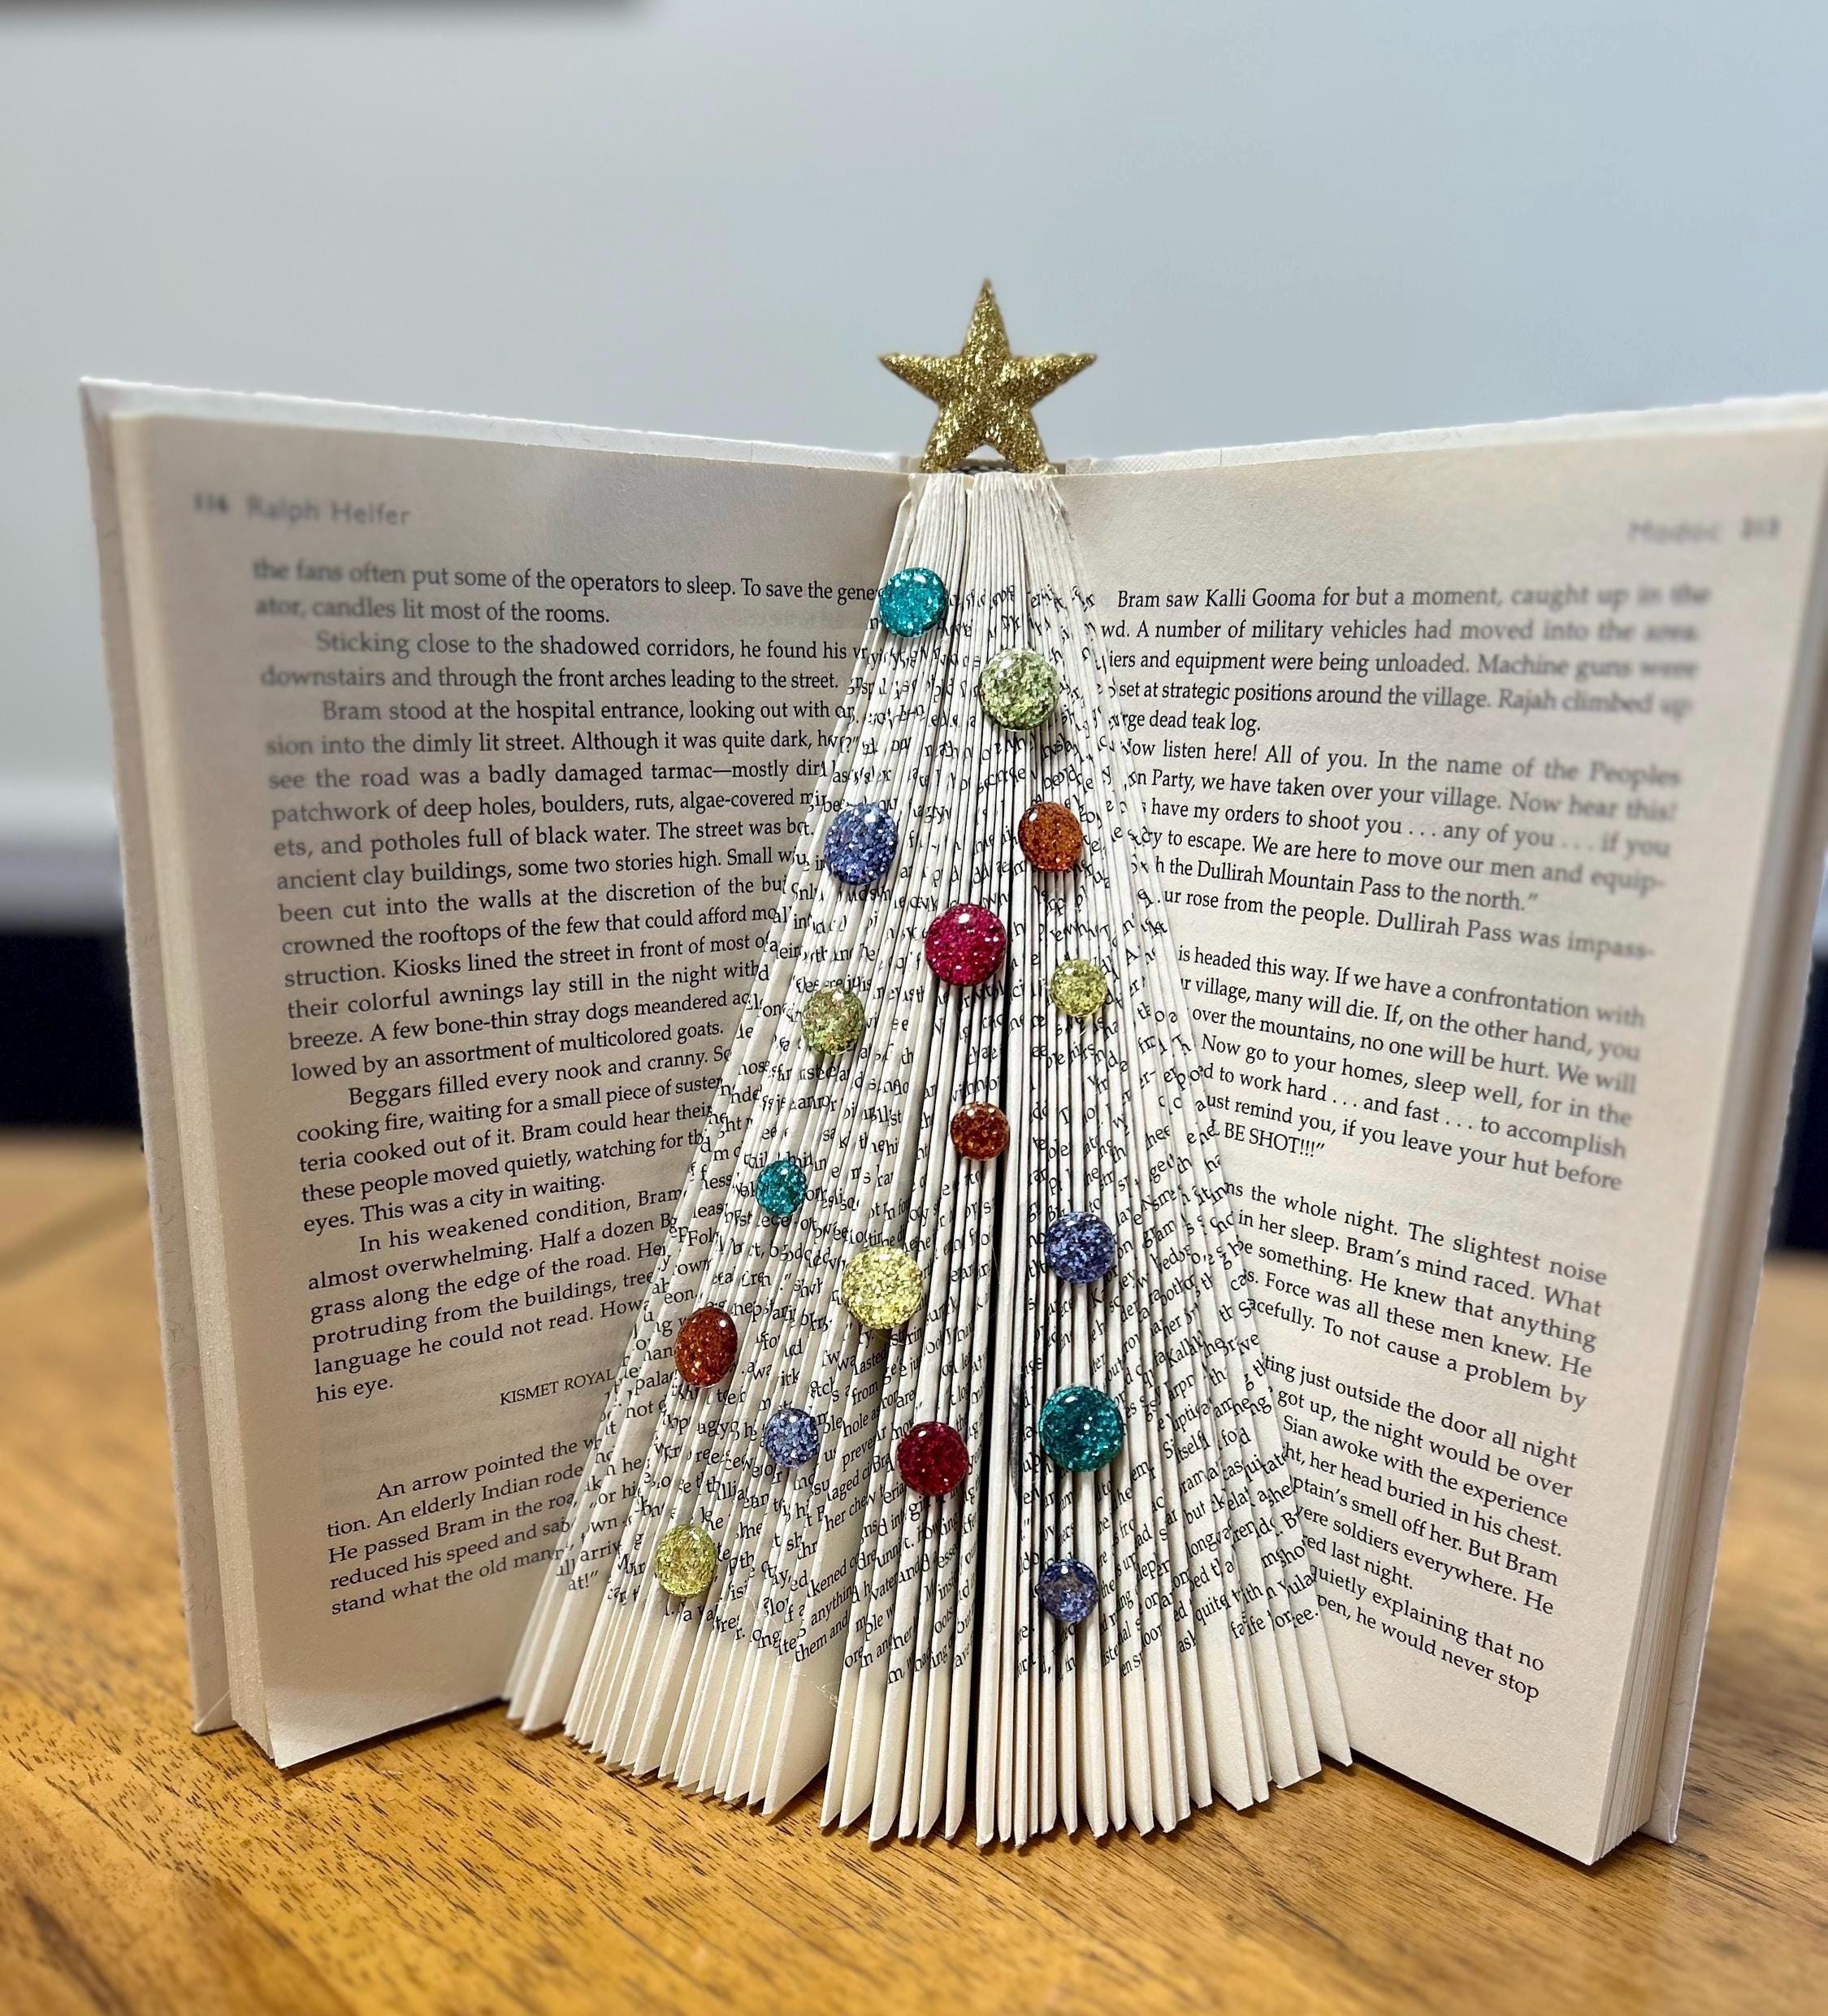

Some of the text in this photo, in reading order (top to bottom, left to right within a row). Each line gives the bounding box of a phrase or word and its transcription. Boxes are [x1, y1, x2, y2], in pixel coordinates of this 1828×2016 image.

[246, 494, 320, 529] Ralph
[330, 501, 412, 526] Helfer
[310, 596, 397, 619] candles
[401, 597, 425, 619] lit
[430, 602, 481, 621] most
[486, 600, 506, 621] of
[510, 600, 540, 622] the
[545, 608, 609, 623] rooms.
[1117, 590, 1160, 608] Bram
[1166, 594, 1200, 608] saw
[1204, 587, 1246, 607] Kalli
[1252, 587, 1316, 607] Gooma
[1322, 586, 1350, 606] for
[1356, 585, 1388, 606] but
[1393, 591, 1405, 605] a
[1410, 587, 1504, 608] moment,
[1510, 583, 1590, 613] caught
[315, 629, 847, 661] Sticking close to the shadowed corridors, he found his
[1119, 681, 1141, 697] set
[1143, 682, 1159, 698] at
[1162, 682, 1231, 706] strategic
[1232, 683, 1312, 707] positions
[1316, 684, 1382, 705] around
[1388, 684, 1418, 706] the
[1422, 686, 1491, 715] village.
[1497, 687, 1557, 716] Rajah
[268, 774, 305, 790] see
[314, 767, 351, 788] the
[360, 766, 410, 787] road
[419, 770, 460, 786] was
[469, 770, 480, 784] a
[487, 763, 547, 789] badly
[555, 761, 643, 787] damaged
[1169, 856, 1193, 877] the
[1197, 860, 1264, 884] Dullirah
[1267, 867, 1354, 893] Mountain
[1358, 876, 1401, 898] Pass
[1406, 882, 1425, 900] to
[1431, 882, 1462, 904] the
[284, 934, 751, 988] struction. Kiosks lined the street in front of most
[1177, 944, 1646, 1029] is headed this way. If we have a confrontation with
[291, 1021, 724, 1082] lowed by an assortment of multicolored goats.
[1201, 1033, 1632, 1127] Now go to your homes, sleep well, for in the
[299, 1110, 670, 1173] teria cooked out of it. Bram could hear
[1224, 1121, 1245, 1142] BE
[1237, 1209, 1254, 1228] in
[1258, 1213, 1286, 1236] her
[1290, 1224, 1339, 1254] sleep.
[1414, 1259, 1467, 1284] mind
[1473, 1274, 1535, 1300] raced.
[1544, 1285, 1602, 1317] What
[310, 1246, 630, 1324] grass along the edge of the road.
[315, 1378, 393, 1403] his eye.
[500, 1368, 617, 1406] KISMET ROYAL
[851, 1381, 878, 1406] from
[626, 1401, 654, 1419] not
[1283, 1415, 1568, 1528] Sian awoke with the experience
[326, 1463, 585, 1537] tion. An elderly Indian rode
[1183, 1501, 1206, 1525] but
[1185, 1533, 1219, 1559] long
[1330, 1541, 1413, 1590] last night.
[331, 1587, 386, 1615] stand
[391, 1576, 440, 1600] what
[444, 1569, 474, 1586] the
[479, 1555, 508, 1577] old
[795, 1633, 828, 1663] them
[1355, 1606, 1376, 1629] he
[1380, 1622, 1436, 1657] would
[1440, 1649, 1494, 1680] never
[1498, 1673, 1540, 1704] stop
